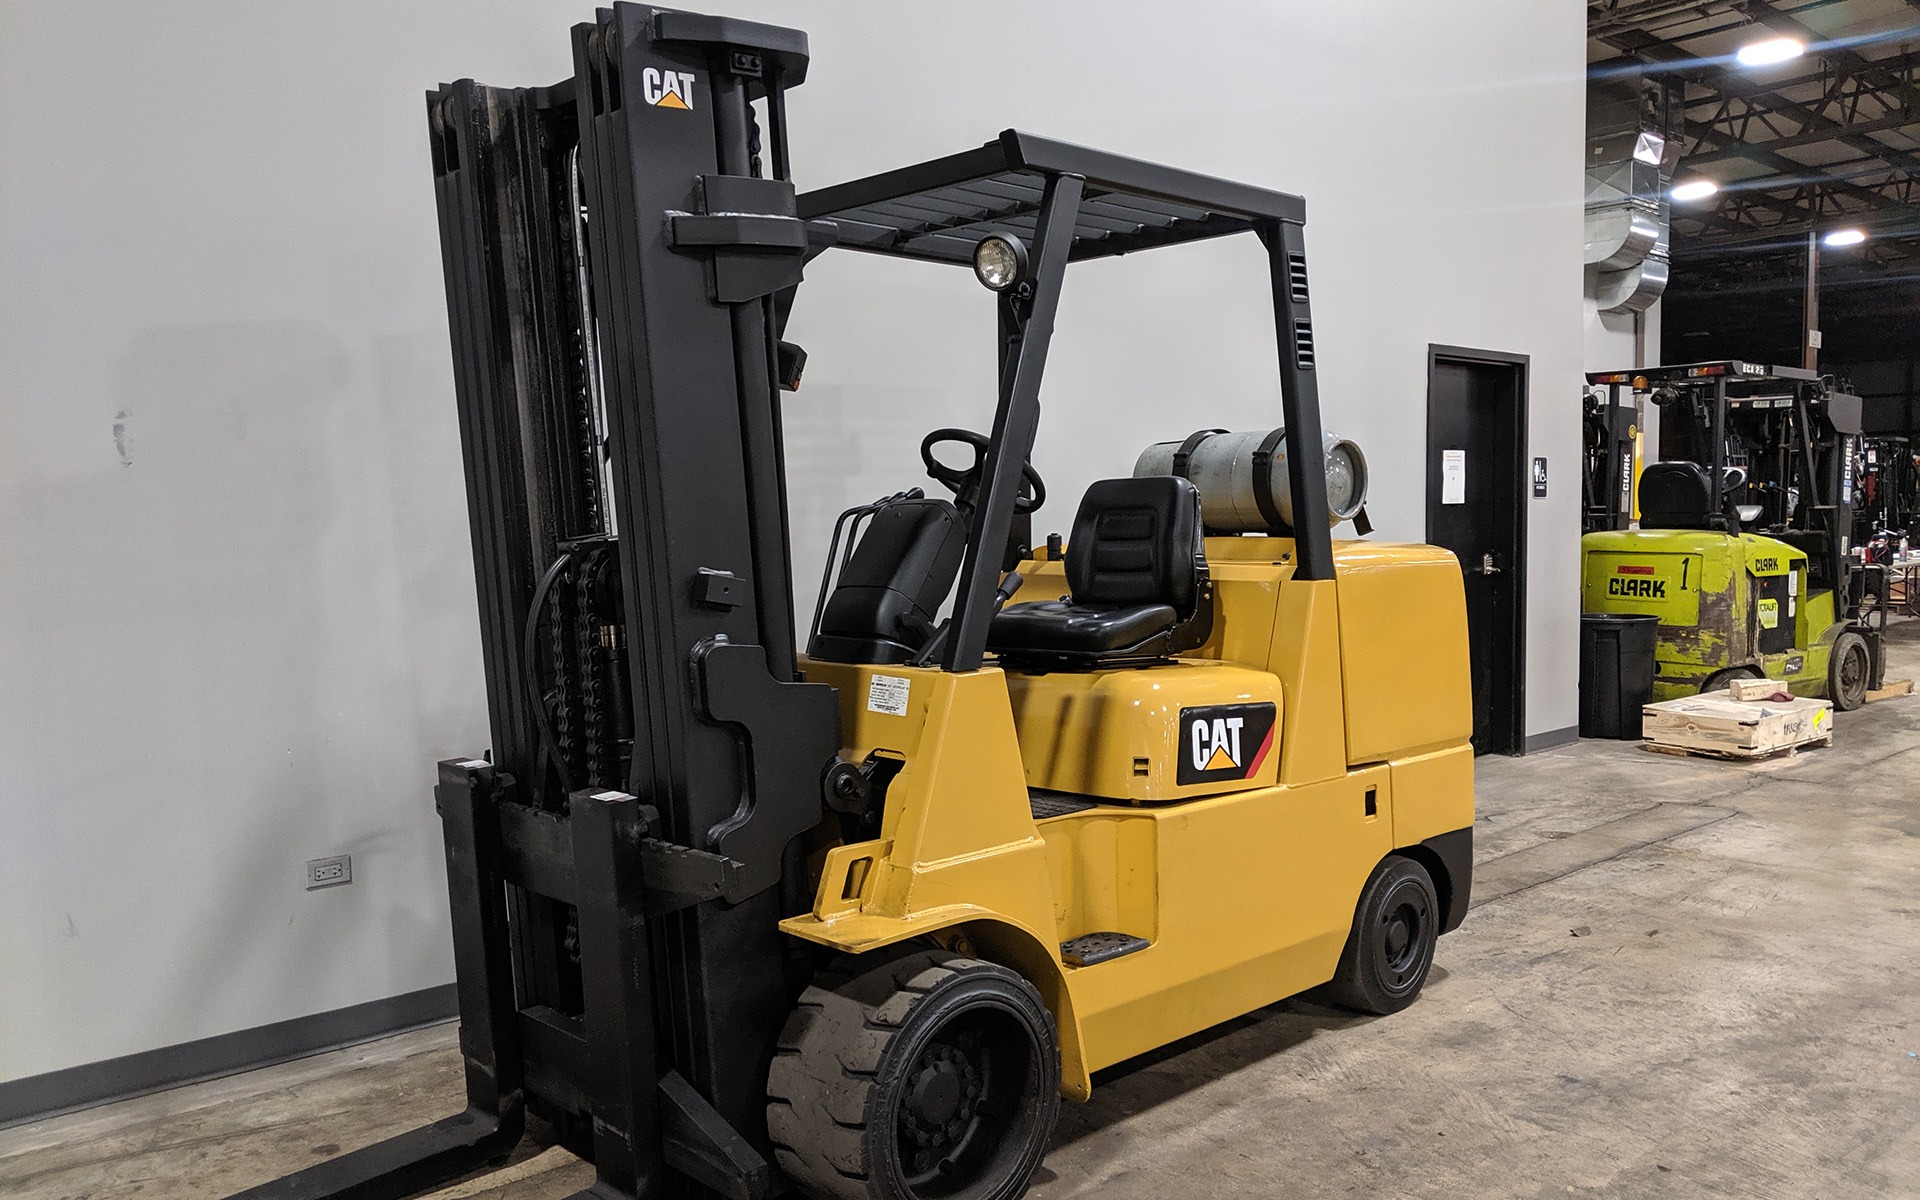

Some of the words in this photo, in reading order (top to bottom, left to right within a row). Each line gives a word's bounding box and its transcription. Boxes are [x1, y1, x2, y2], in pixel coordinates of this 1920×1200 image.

[643, 67, 695, 111] CAT
[1622, 453, 1631, 492] CLARK
[1844, 438, 1853, 480] CLARK
[1680, 557, 1690, 590] 1
[1755, 558, 1778, 572] CLARK
[1608, 577, 1666, 598] CLARK
[1192, 717, 1244, 771] CAT
